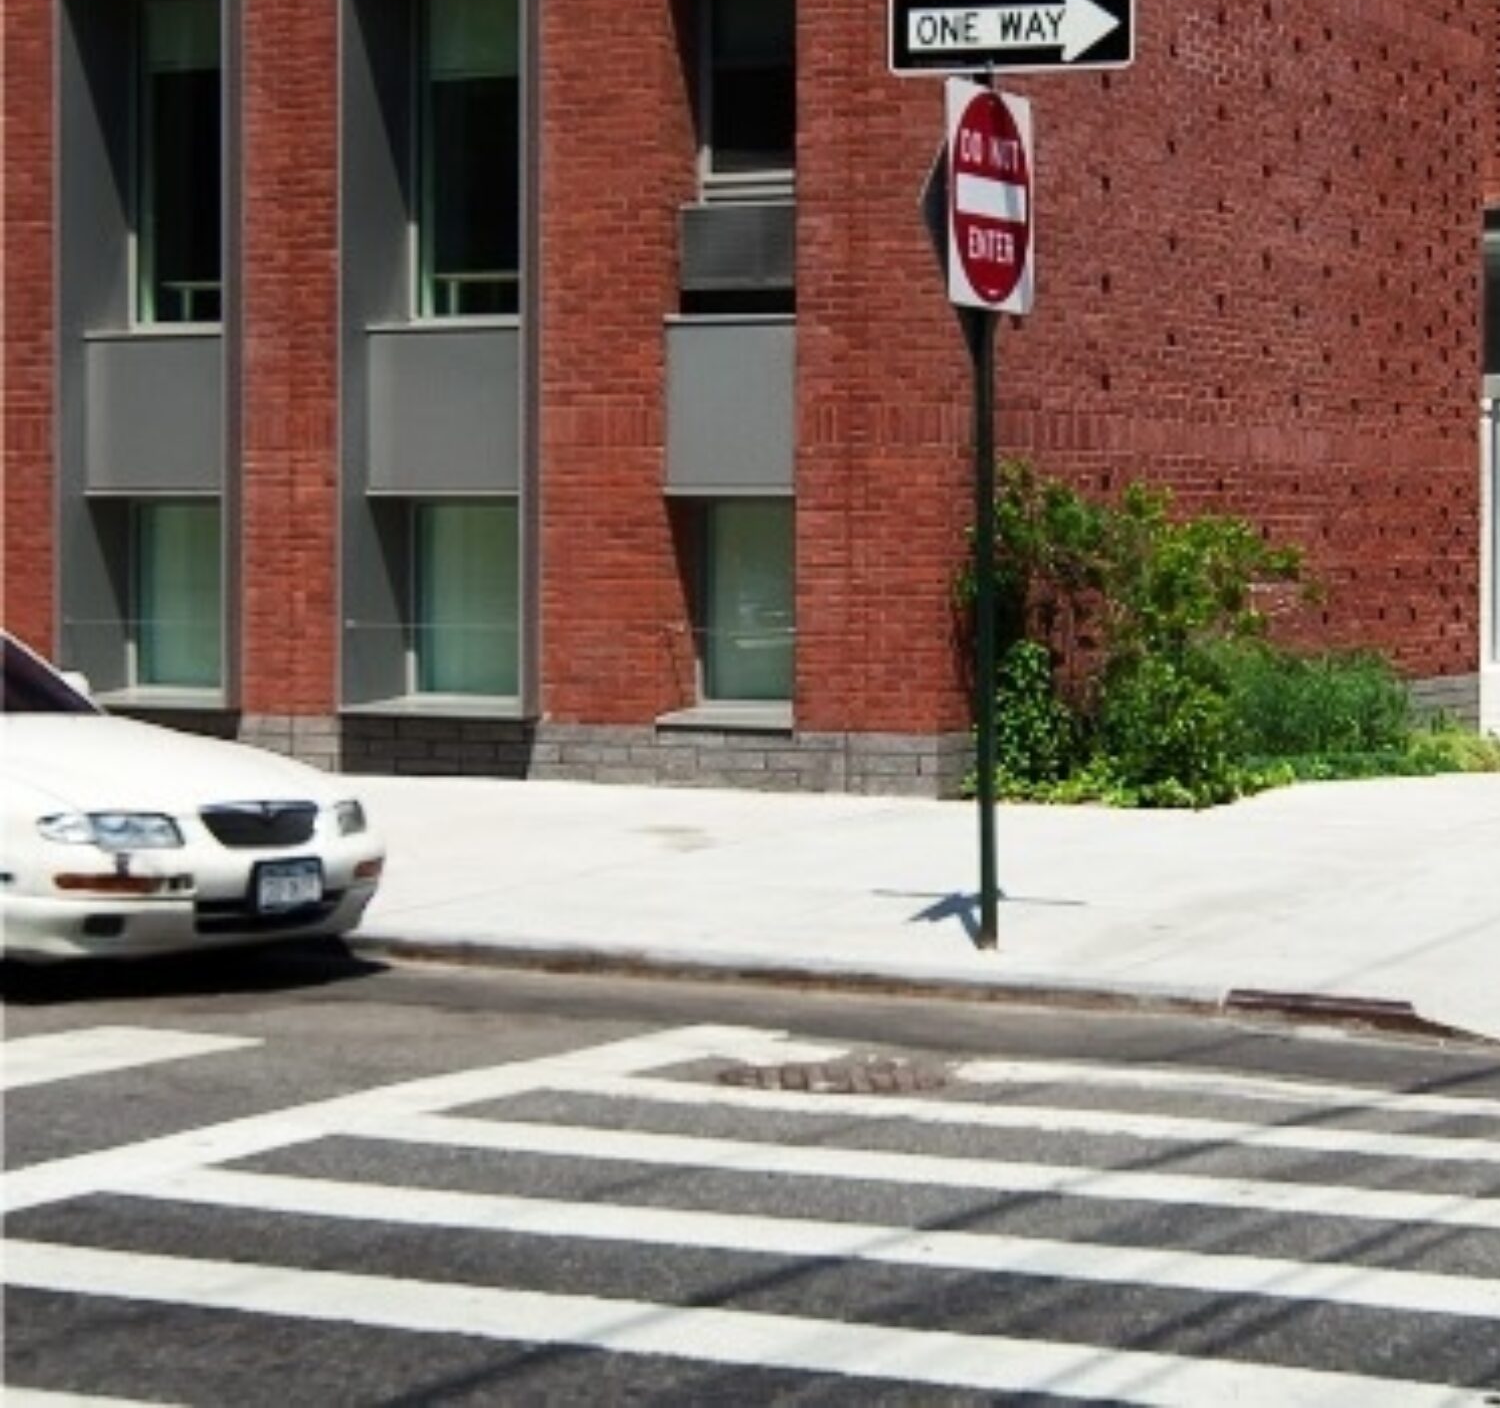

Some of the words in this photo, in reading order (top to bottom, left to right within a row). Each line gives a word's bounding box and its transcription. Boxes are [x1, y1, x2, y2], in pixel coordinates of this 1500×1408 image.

[916, 11, 979, 45] ONE
[999, 8, 1066, 42] WAY
[960, 127, 982, 164] DO
[967, 225, 1015, 265] ENTER
